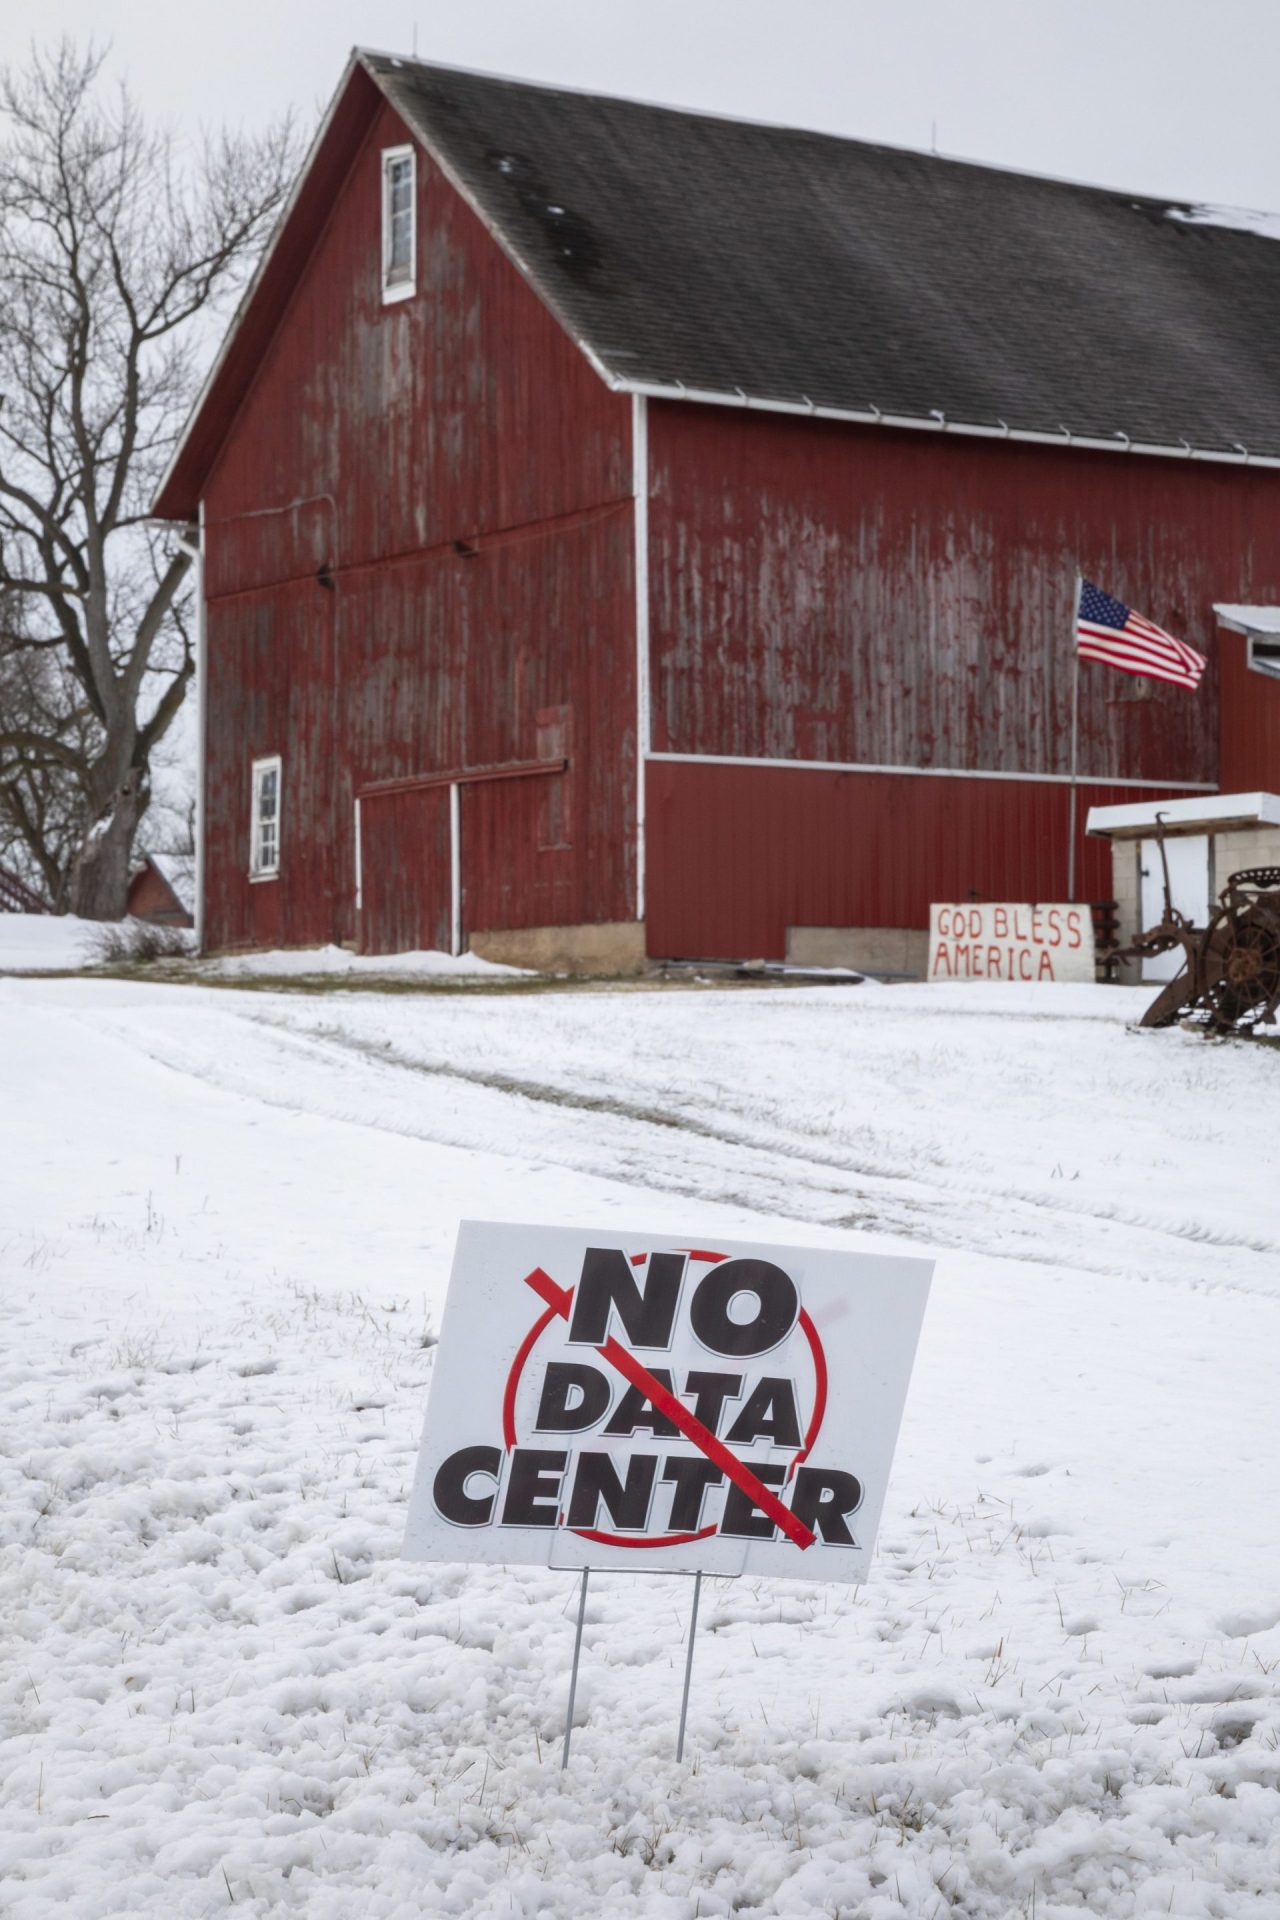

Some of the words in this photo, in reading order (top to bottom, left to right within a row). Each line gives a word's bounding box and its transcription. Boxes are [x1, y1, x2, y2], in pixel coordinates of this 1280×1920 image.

[932, 942, 1056, 982] AMERICA
[938, 908, 983, 939] GOD
[994, 907, 1082, 949] BLESS
[567, 1247, 800, 1358] NO
[533, 1361, 805, 1449] DATA
[433, 1445, 863, 1548] CENTER
